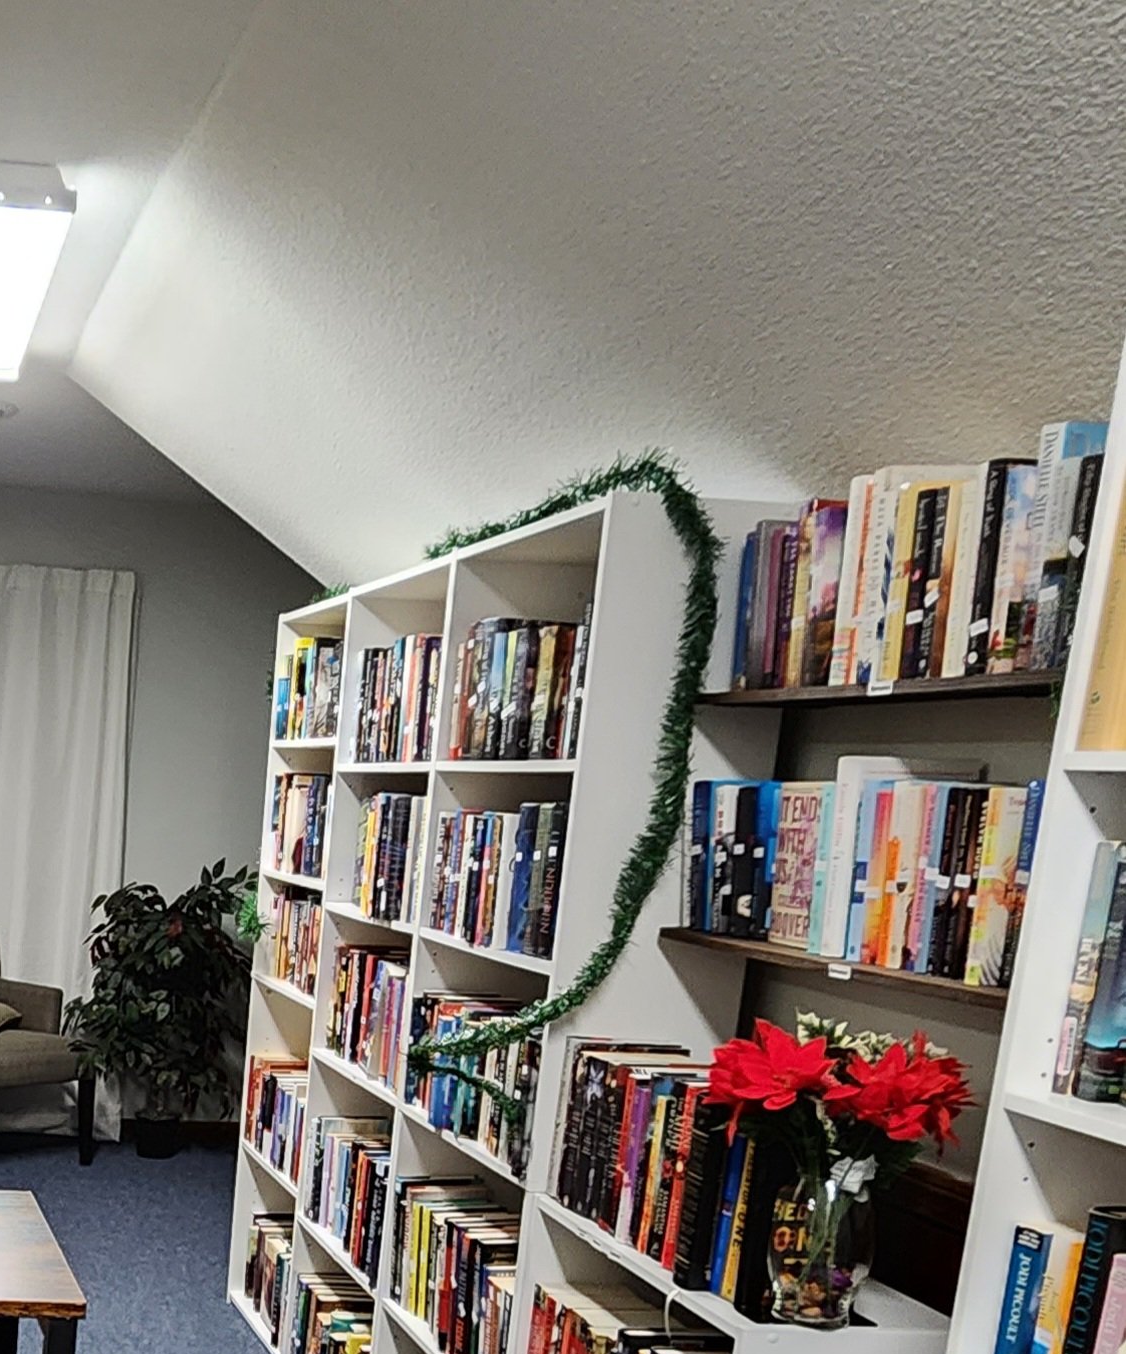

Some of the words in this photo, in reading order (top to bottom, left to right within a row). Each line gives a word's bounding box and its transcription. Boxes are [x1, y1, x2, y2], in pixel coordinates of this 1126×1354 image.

[1014, 1252, 1033, 1285] JODI
[1083, 1218, 1111, 1271] JODI
[1005, 1285, 1027, 1343] PICOULT
